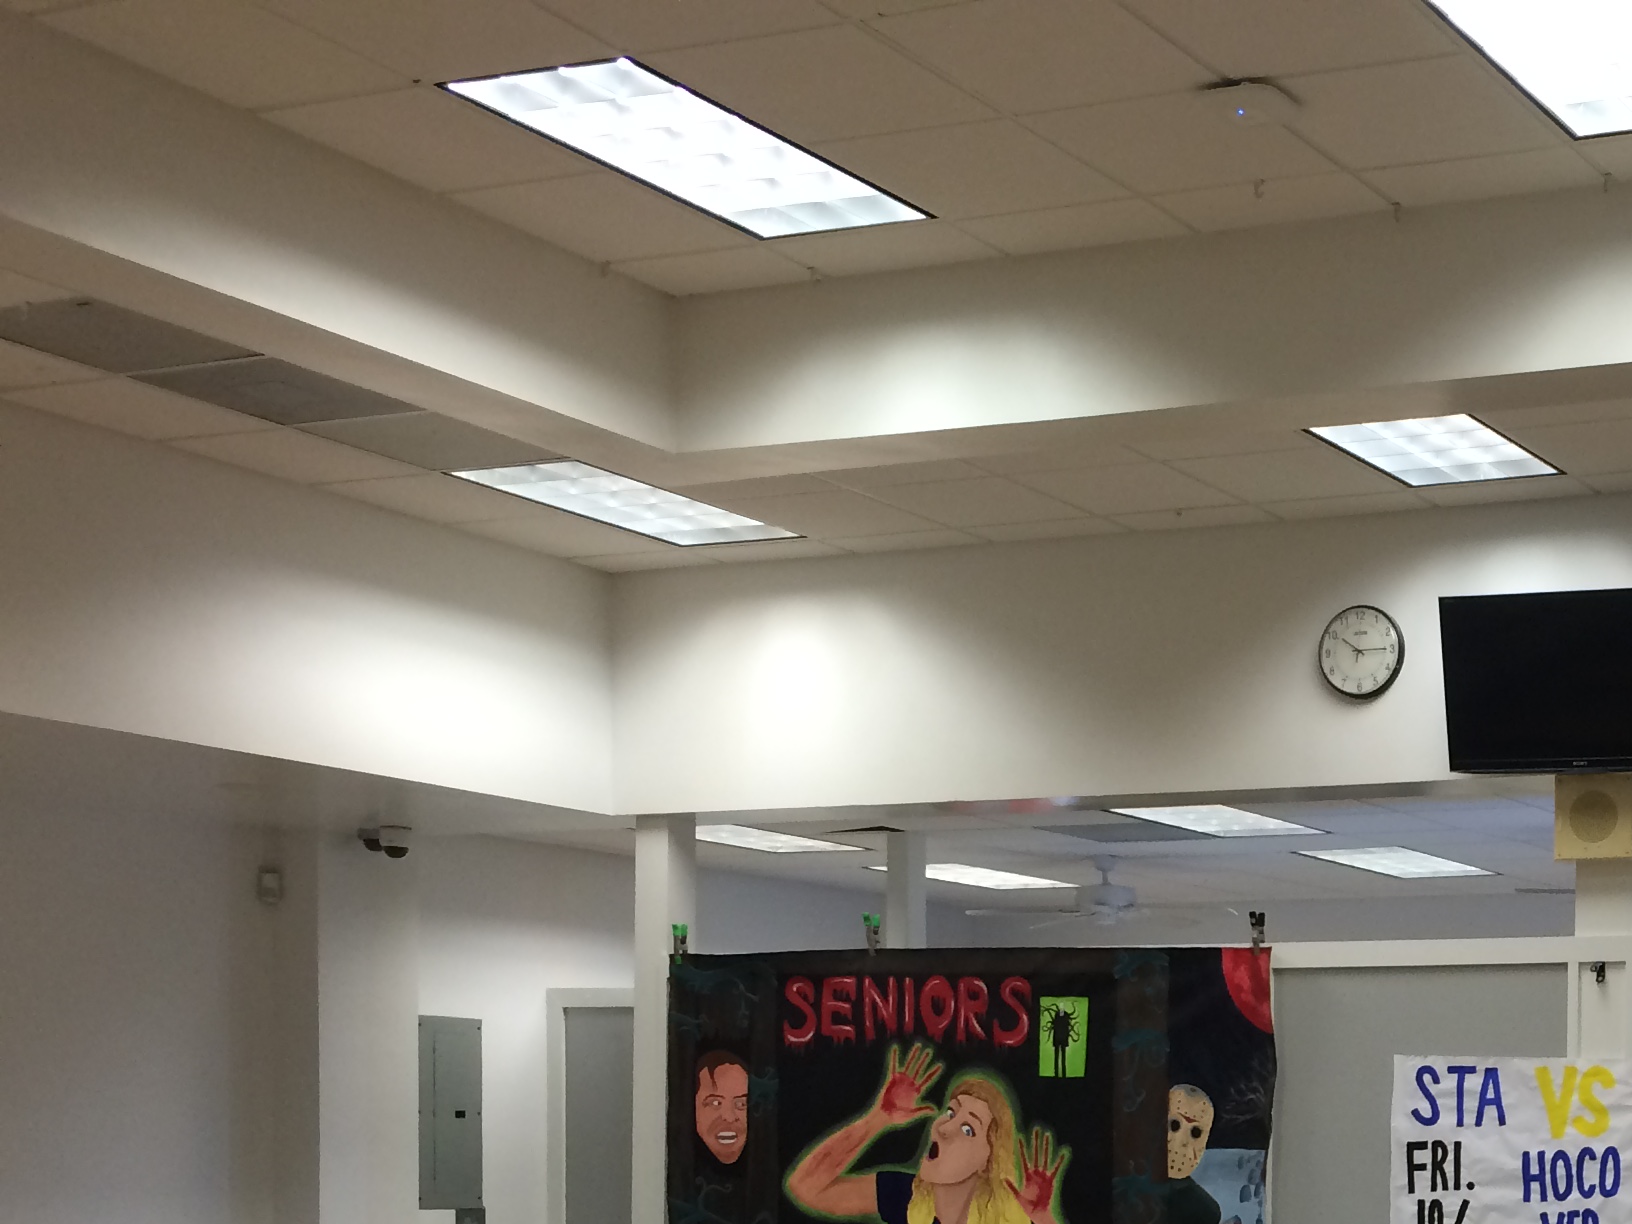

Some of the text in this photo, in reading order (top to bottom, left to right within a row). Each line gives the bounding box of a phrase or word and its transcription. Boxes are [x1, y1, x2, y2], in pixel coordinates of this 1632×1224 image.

[1355, 611, 1366, 620] 12
[1374, 614, 1379, 624] 1
[1385, 627, 1391, 637] 2
[1389, 644, 1395, 654] 3
[783, 975, 1032, 1050] SENIORS
[1411, 1065, 1507, 1127] STA
[1534, 1066, 1616, 1139] VS
[1406, 1140, 1475, 1194] FRI.
[1522, 1146, 1621, 1203] HOCO
